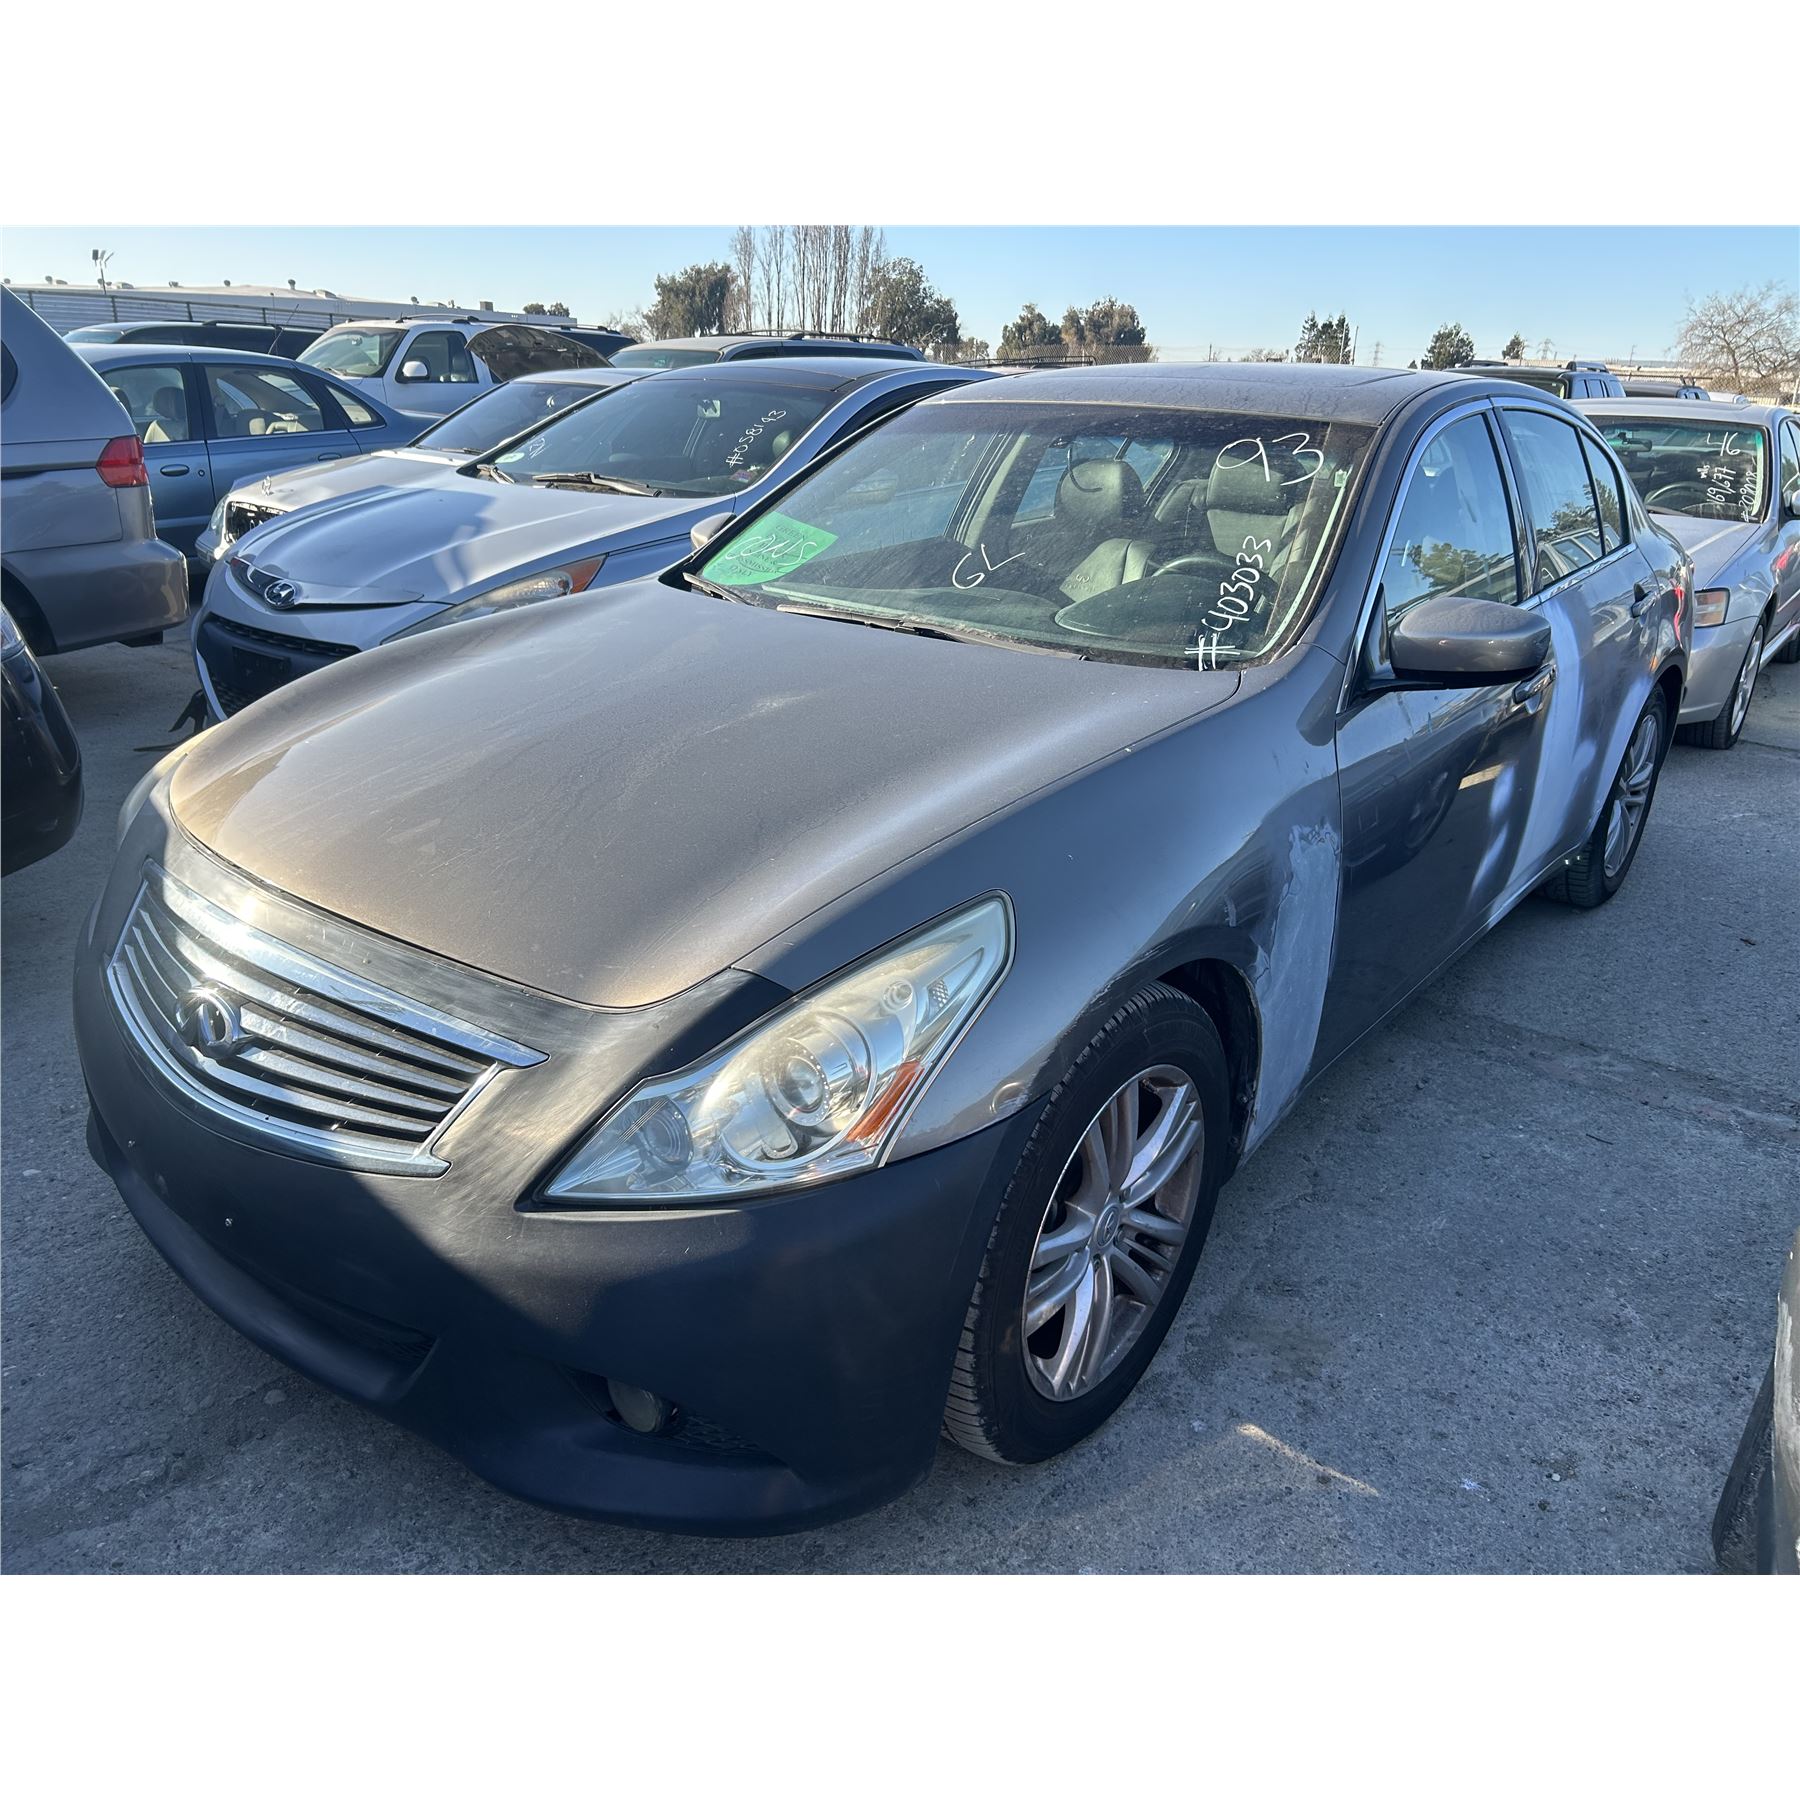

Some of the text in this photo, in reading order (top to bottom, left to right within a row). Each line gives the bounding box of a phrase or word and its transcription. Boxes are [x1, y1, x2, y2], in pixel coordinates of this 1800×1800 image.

[725, 410, 787, 468] #058193
[1215, 432, 1324, 486] 93
[1706, 431, 1741, 456] 46
[1183, 534, 1273, 672] #403033
